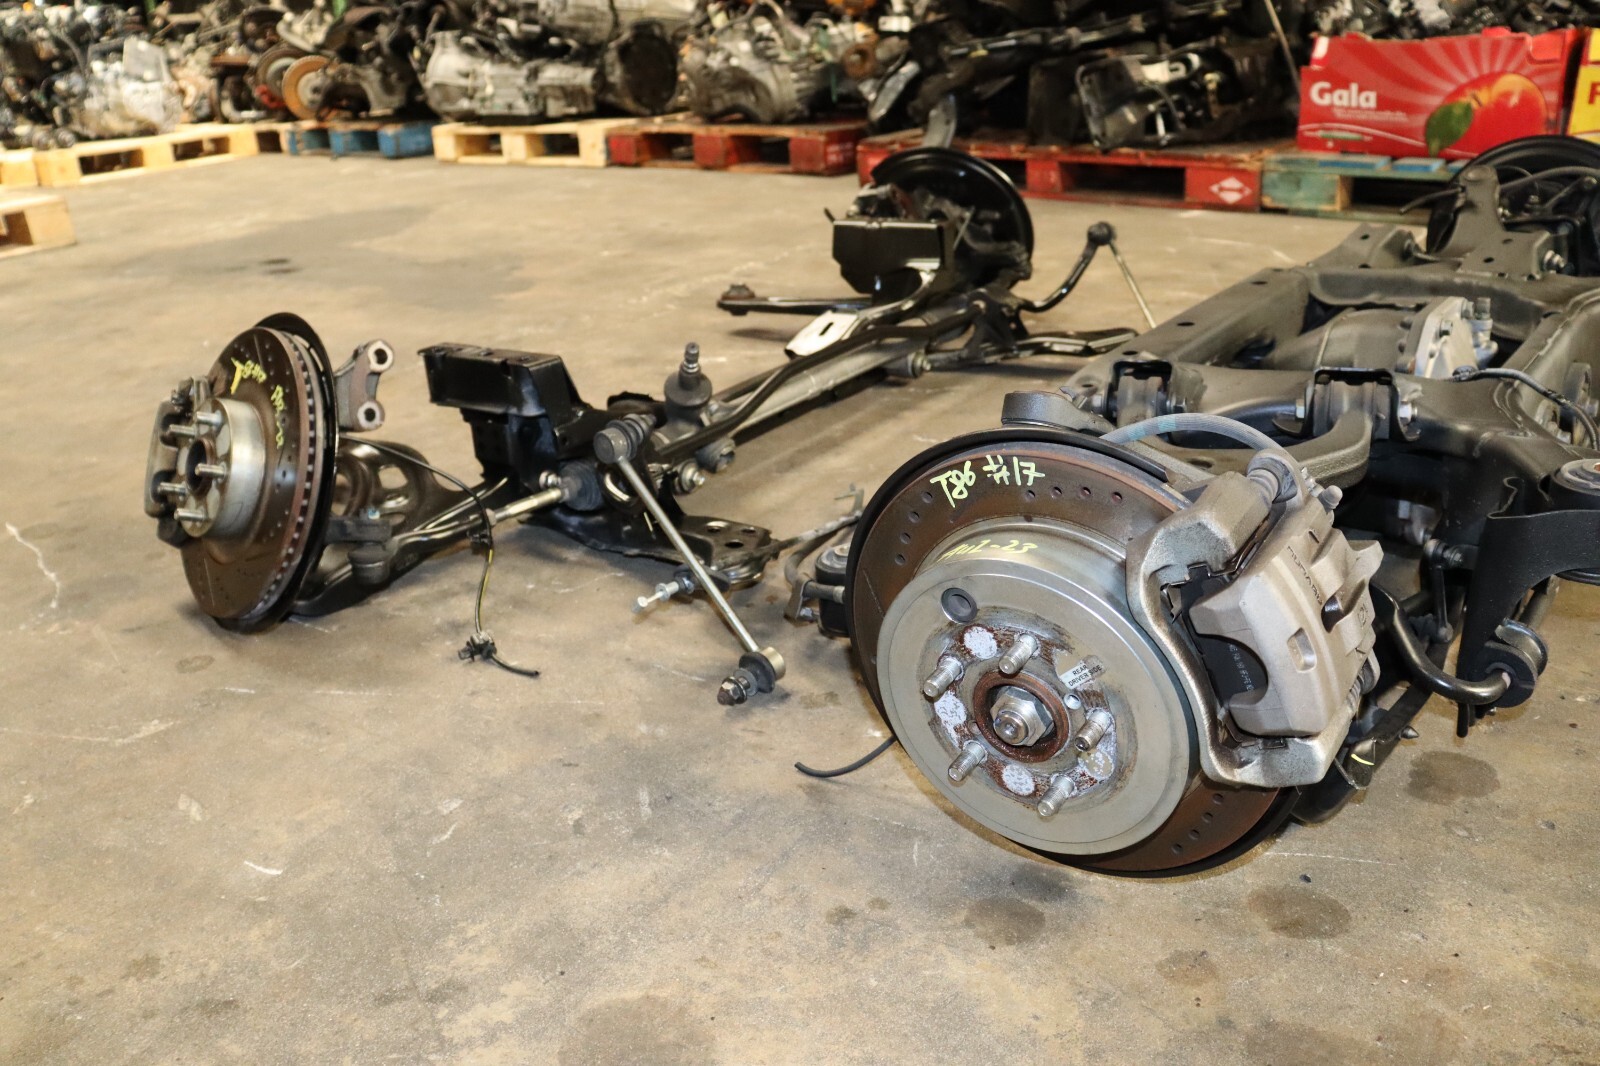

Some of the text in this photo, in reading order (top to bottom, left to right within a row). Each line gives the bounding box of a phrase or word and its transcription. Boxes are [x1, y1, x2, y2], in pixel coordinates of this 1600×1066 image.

[1310, 81, 1377, 109] Gala
[1068, 664, 1102, 686] DRIVER SIDE
[1072, 664, 1088, 676] REAR
